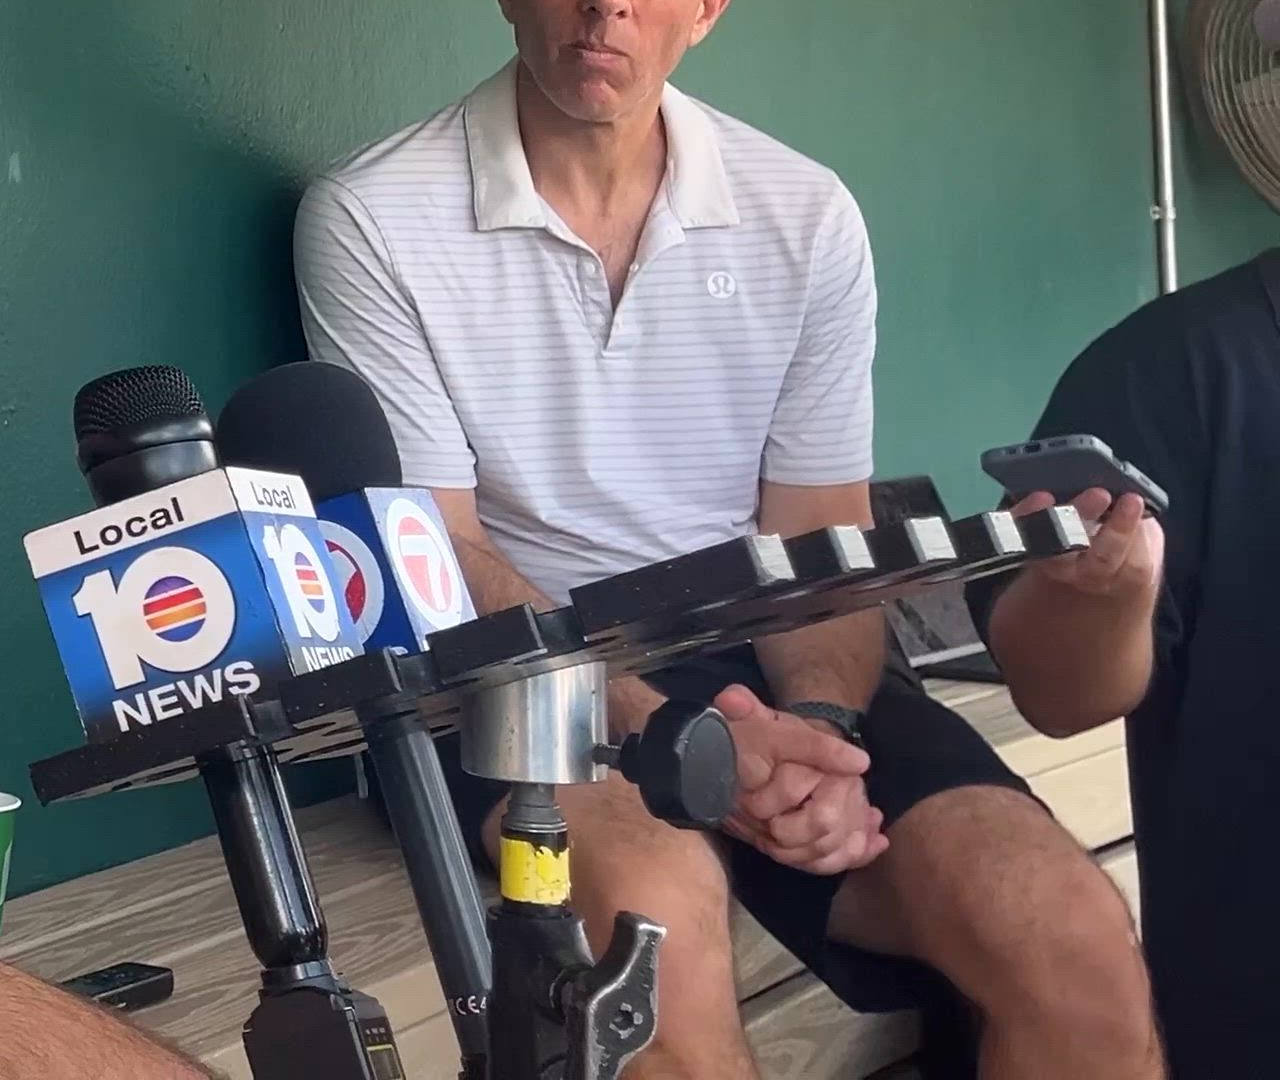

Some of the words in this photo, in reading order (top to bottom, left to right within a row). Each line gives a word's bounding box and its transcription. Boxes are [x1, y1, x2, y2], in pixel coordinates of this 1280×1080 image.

[73, 497, 185, 556] Local
[250, 481, 297, 510] Local
[72, 546, 236, 690] 10
[262, 523, 341, 642] 10
[112, 660, 261, 732] NEWS
